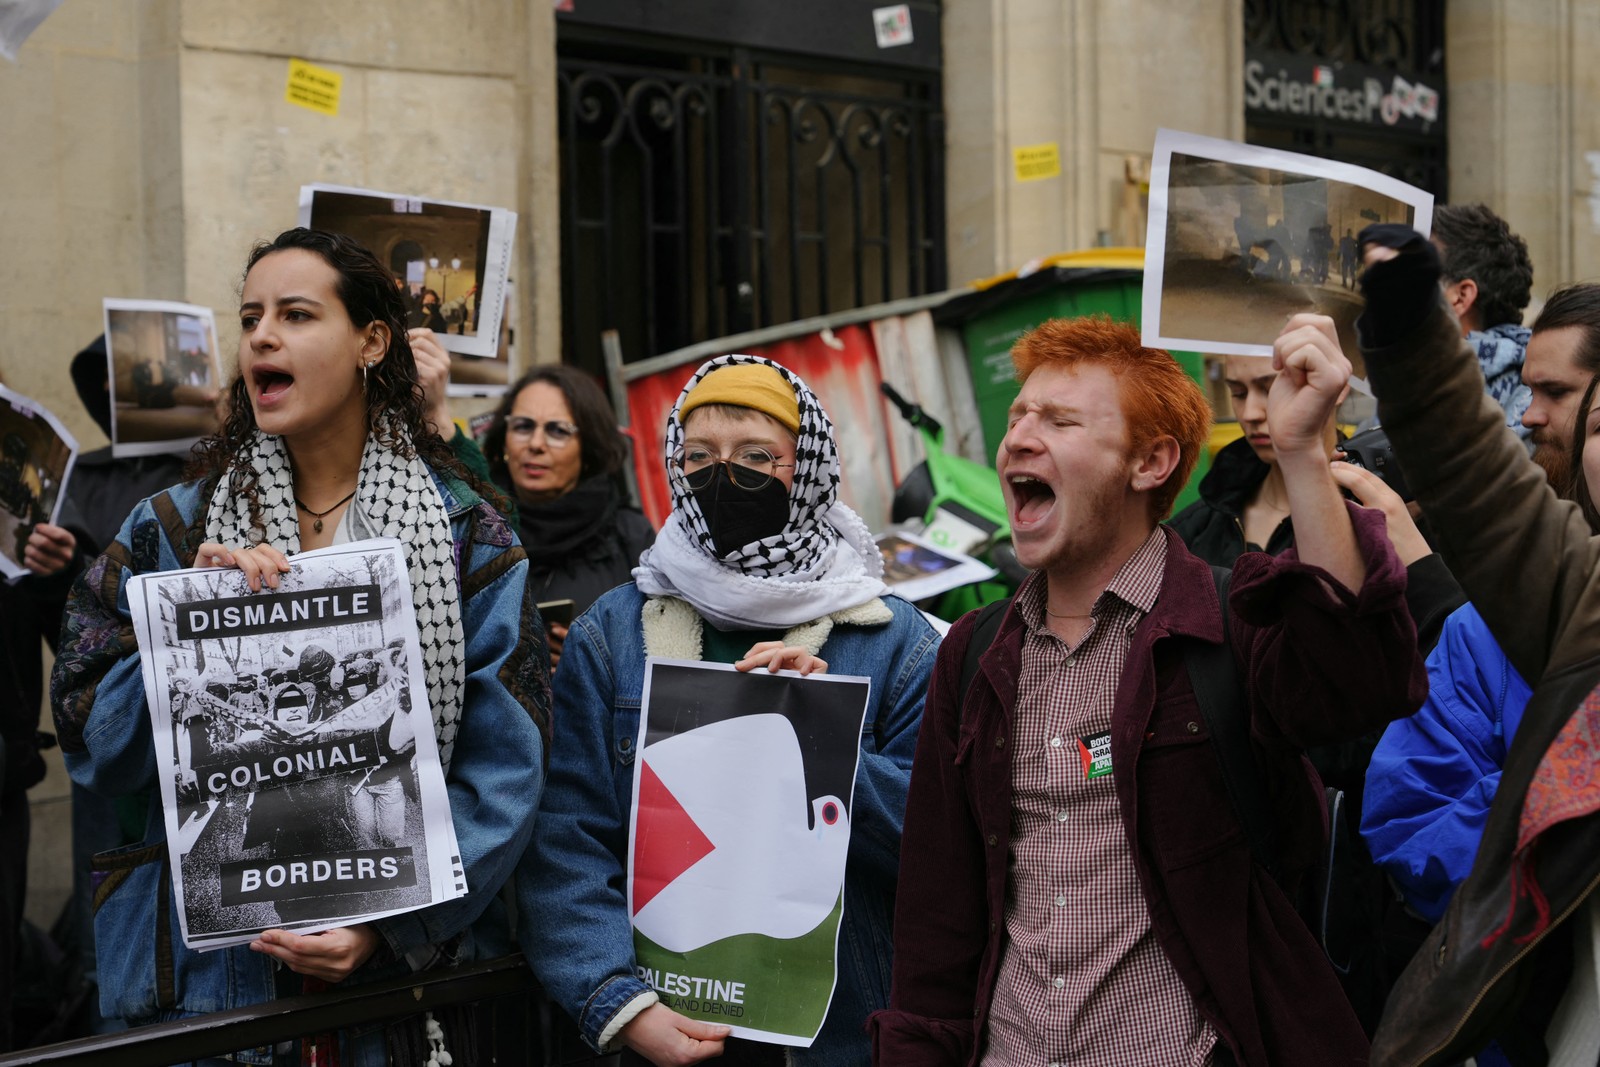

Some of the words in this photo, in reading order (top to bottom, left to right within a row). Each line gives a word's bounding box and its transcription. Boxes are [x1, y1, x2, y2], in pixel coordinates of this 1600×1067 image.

[189, 593, 369, 632] DISMANTLE
[1090, 735, 1112, 748] BOYC
[1092, 746, 1112, 758] ISRA
[206, 743, 367, 794] COLONIAL
[240, 856, 399, 893] BORDERS
[637, 965, 746, 1004] PALESTINE
[702, 1001, 744, 1018] DENIED
